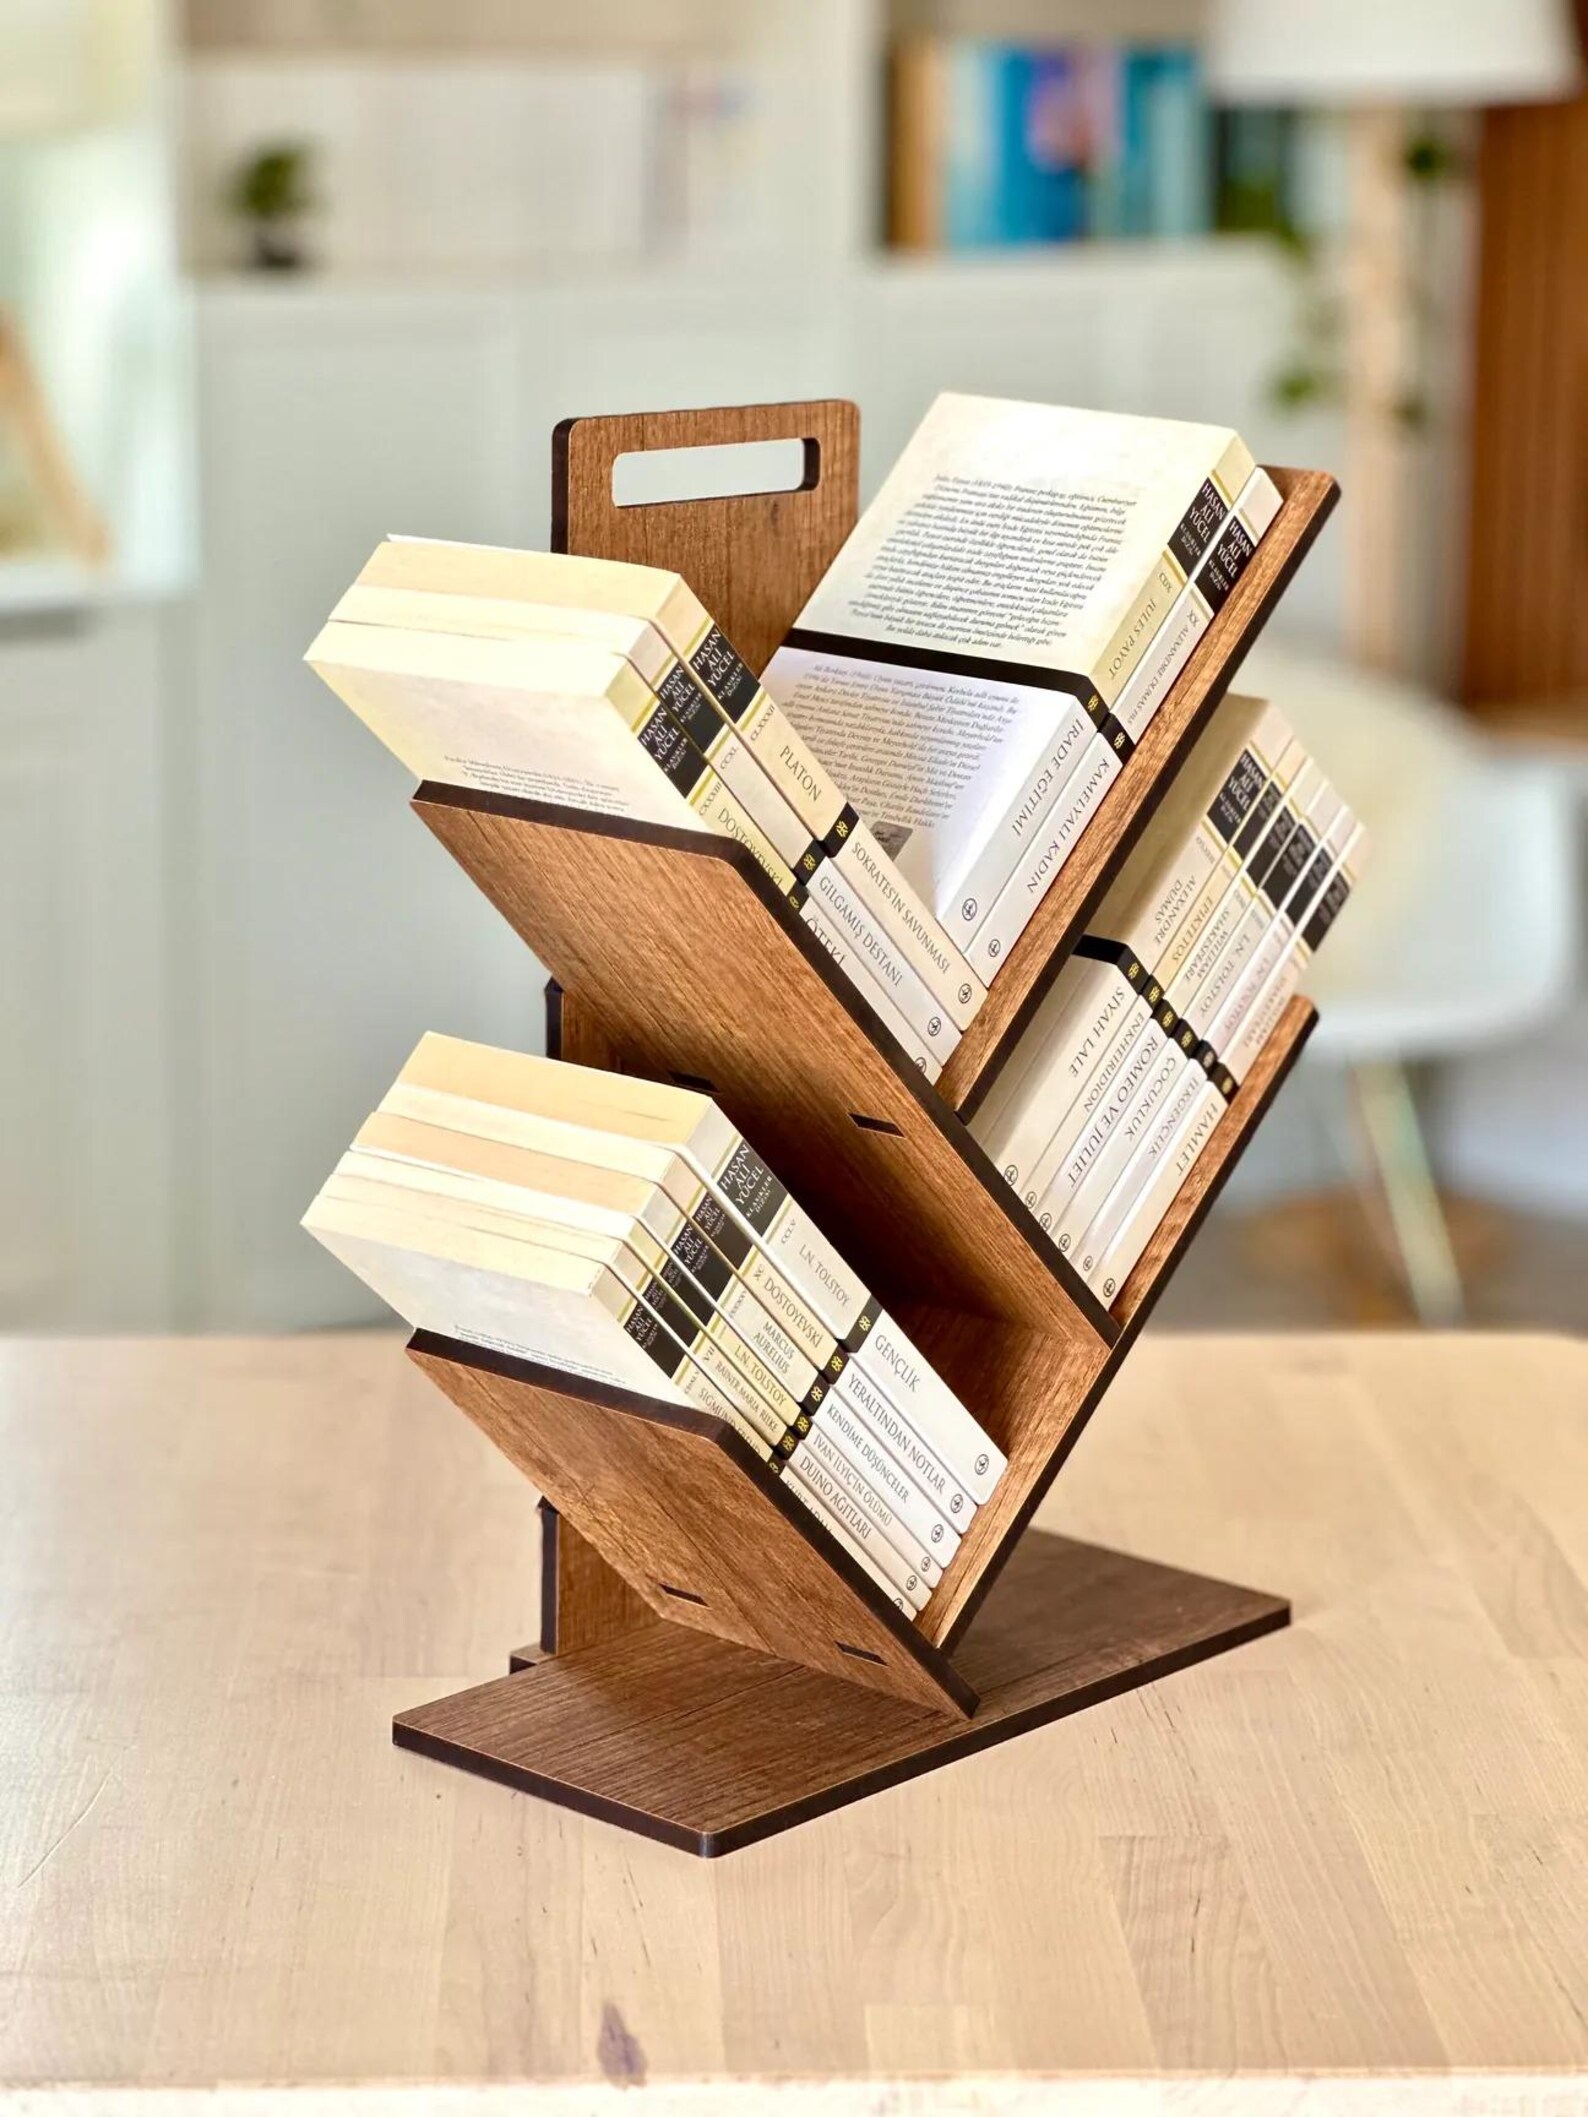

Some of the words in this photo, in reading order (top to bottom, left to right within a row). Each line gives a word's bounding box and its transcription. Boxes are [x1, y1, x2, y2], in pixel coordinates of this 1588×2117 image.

[1202, 483, 1226, 520] HASAN
[1229, 520, 1253, 557] HASAN
[1133, 598, 1158, 635] JULES
[693, 628, 721, 670] HASAN
[1108, 633, 1136, 681] PAYOT
[1157, 624, 1190, 679] ALEXANDRE
[660, 665, 684, 700] HASAN
[640, 707, 667, 746] HASAN
[779, 745, 823, 802] PLATON
[1060, 757, 1111, 842] KAMELYALI
[1027, 839, 1061, 894] KADIN
[1154, 879, 1183, 923] DUMAS
[1154, 875, 1196, 945] ALEXANDRE
[819, 876, 865, 938] GILGAMIŞ
[862, 932, 903, 986] DESTANI
[902, 909, 950, 974] SAVUNMASI
[1184, 906, 1230, 981] SHAKESPEARE
[1200, 960, 1235, 1014] TOLSTOY
[1069, 1038, 1096, 1078] LALE
[1117, 1036, 1159, 1103] ROMEO
[1101, 1106, 1119, 1129] VE
[1176, 1102, 1219, 1177] HAMLET
[719, 1144, 750, 1191] HASAN
[1068, 1127, 1103, 1188] JULIET
[815, 1262, 851, 1307] TOLSTOY
[753, 1331, 790, 1375] AURELIUS
[763, 1321, 795, 1361] MARCUS
[875, 1334, 920, 1393] GENÇLİK
[750, 1362, 787, 1407] TOLSTOY
[848, 1373, 911, 1452] YERALTINDAN
[908, 1446, 947, 1494] NOTLAR
[800, 1456, 833, 1496] DUINO
